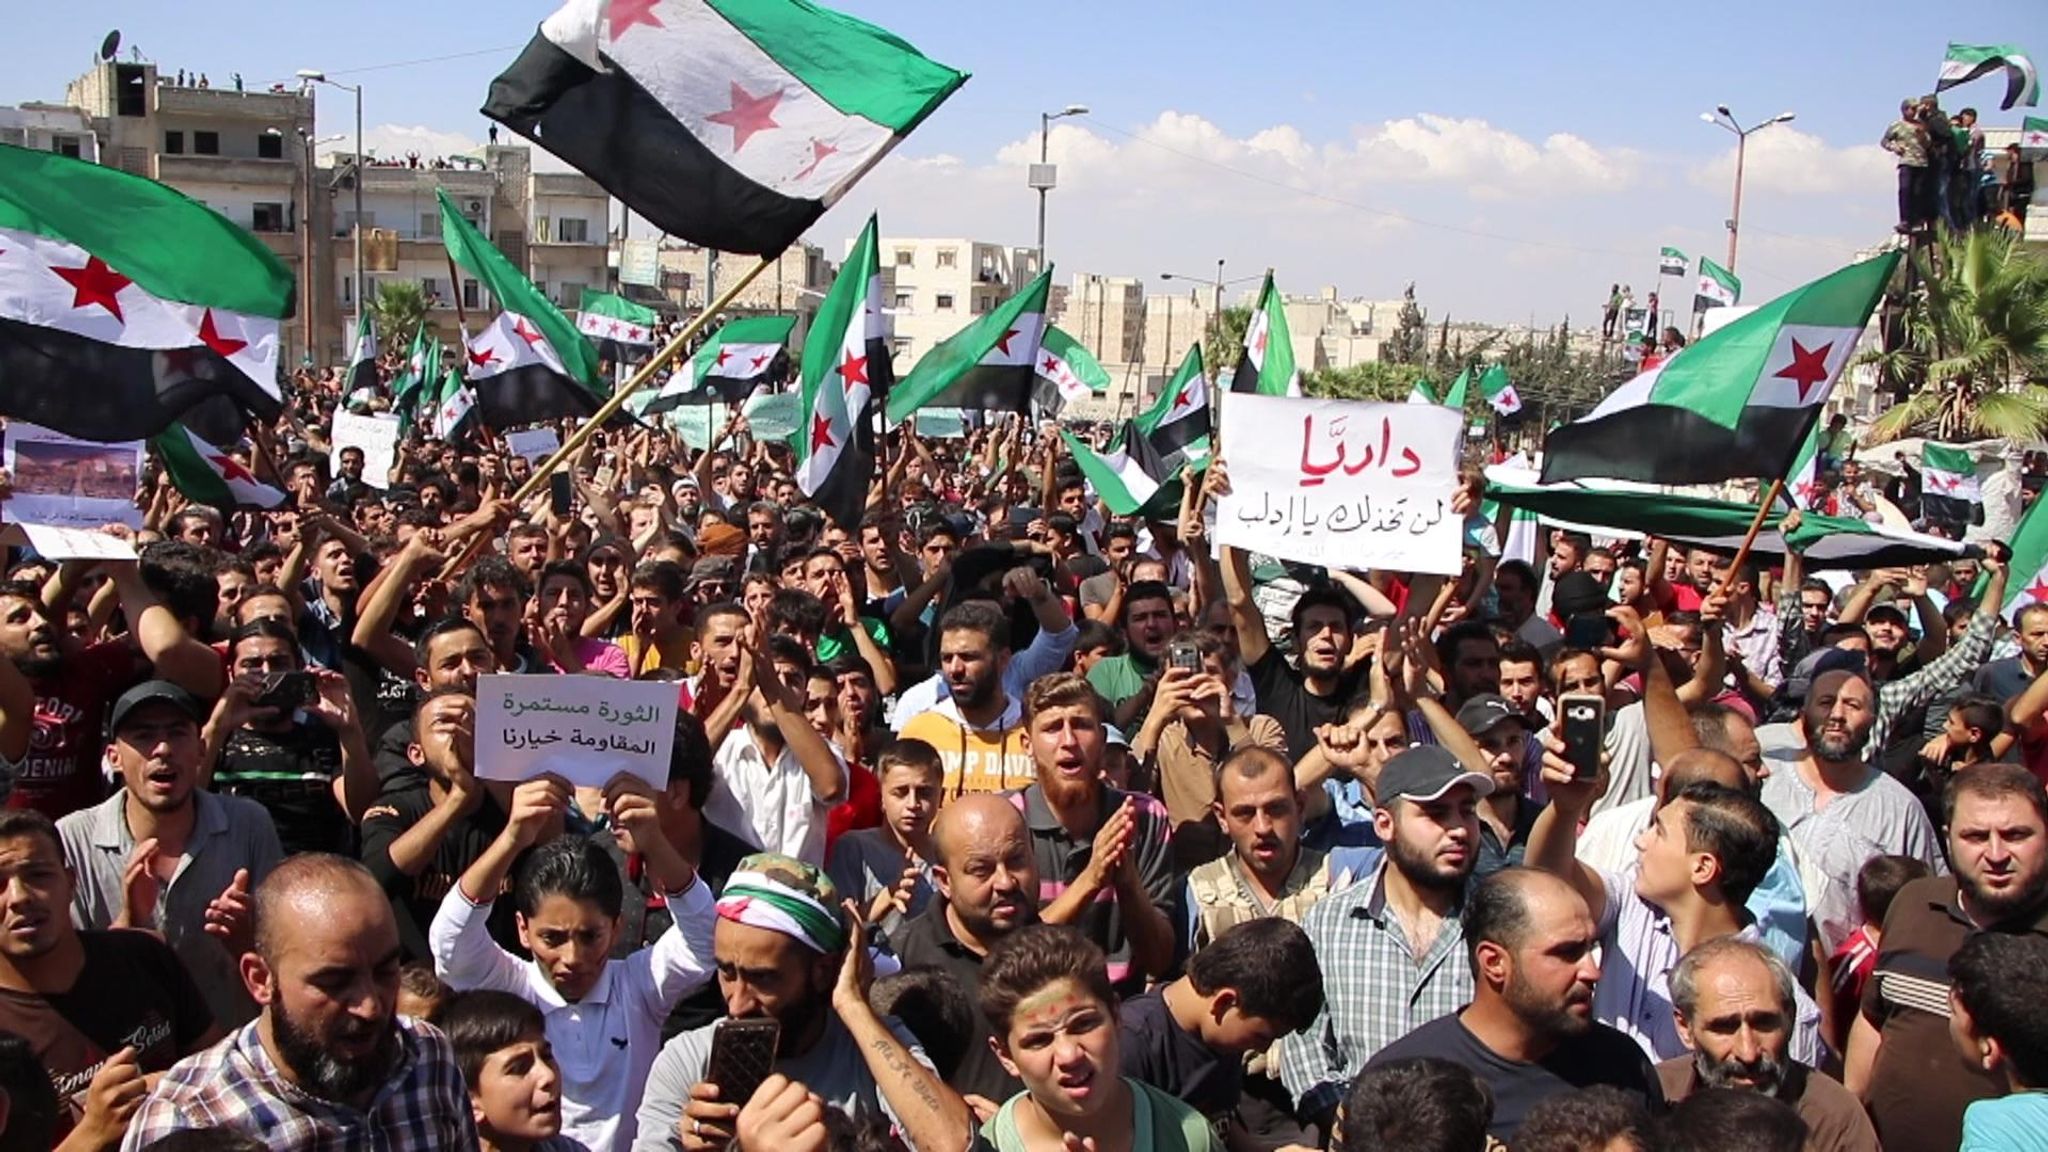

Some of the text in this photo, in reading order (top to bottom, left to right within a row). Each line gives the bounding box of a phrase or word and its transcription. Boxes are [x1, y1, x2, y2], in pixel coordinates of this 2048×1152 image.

[1236, 491, 1295, 537] إدلب
[1301, 496, 1320, 536] يا
[1409, 498, 1444, 535] لن
[503, 692, 660, 726] الثورة مستمرة
[502, 727, 656, 755] المقاومة خيارنا
[984, 751, 1037, 777] DAVI
